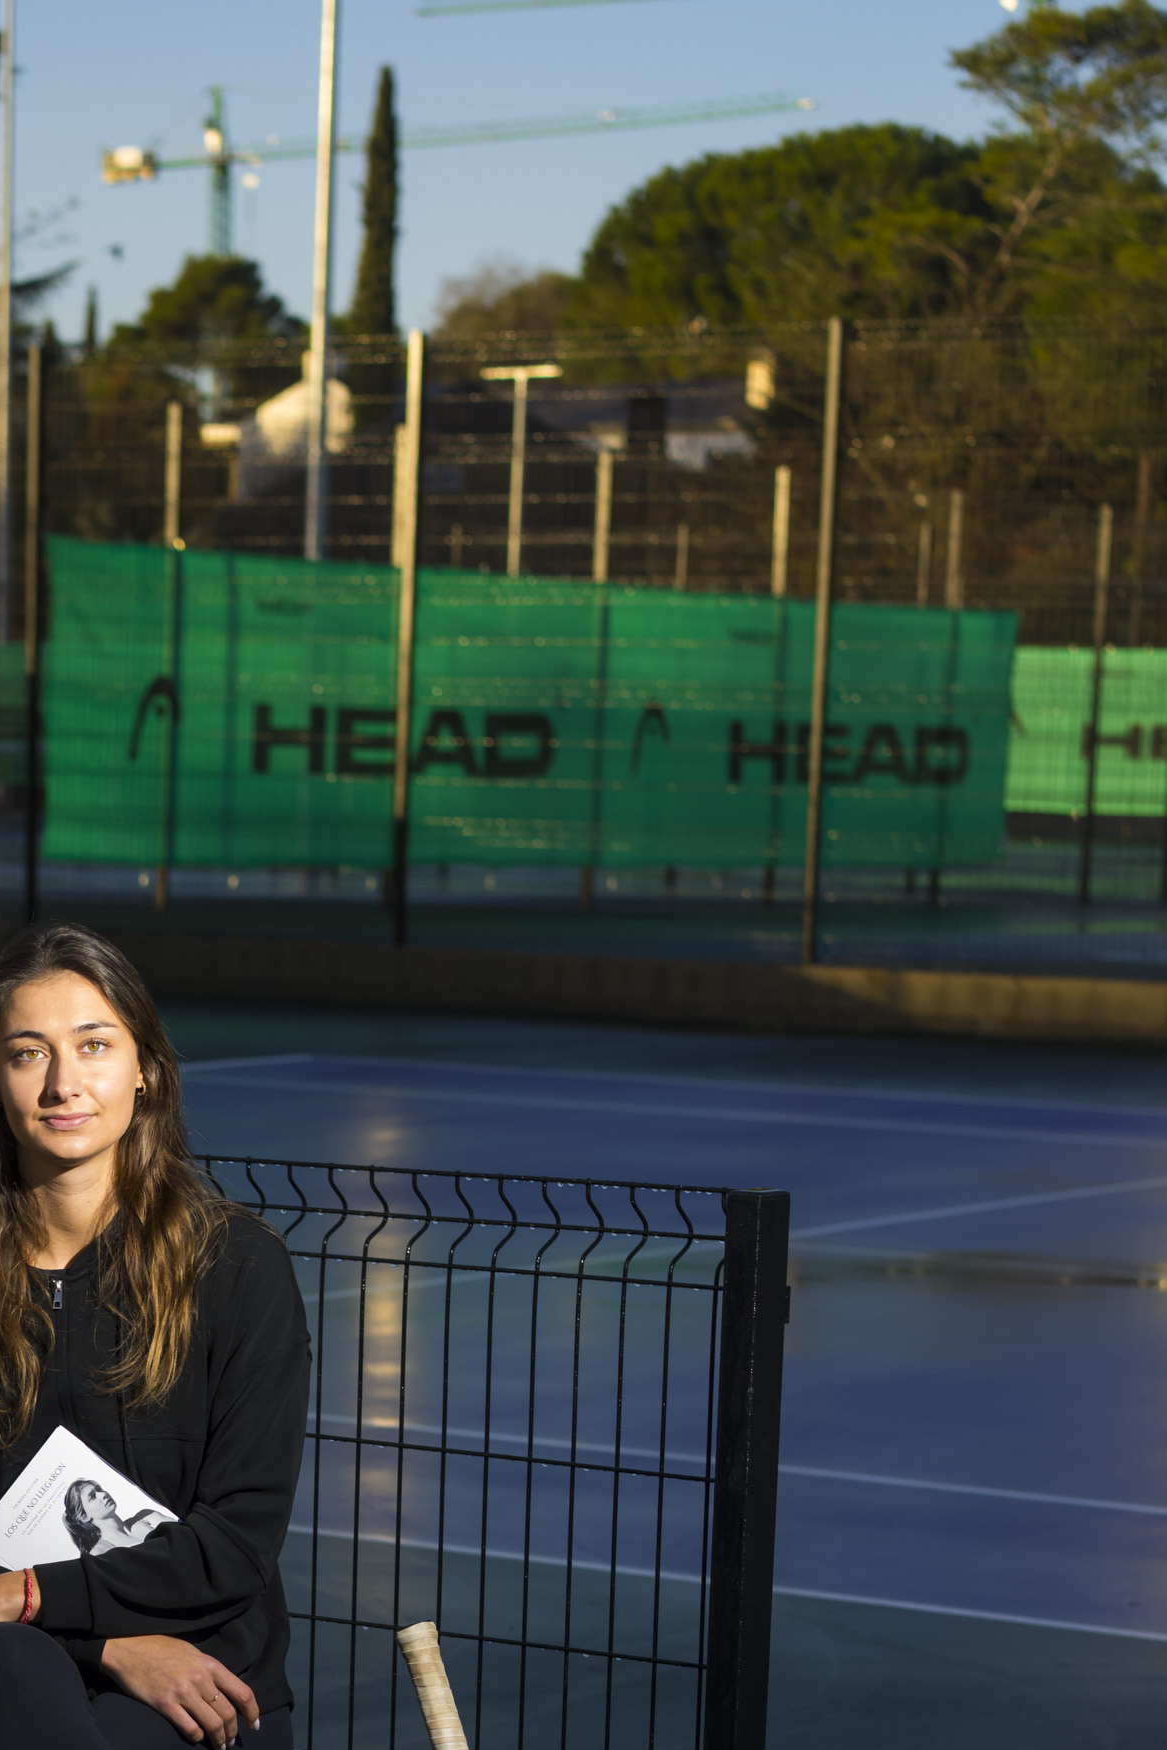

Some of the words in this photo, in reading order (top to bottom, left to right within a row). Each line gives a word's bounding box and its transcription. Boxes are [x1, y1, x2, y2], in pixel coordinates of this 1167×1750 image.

[253, 704, 556, 775] HEAD
[728, 720, 970, 785] HEAD
[3, 1522, 18, 1538] LOS
[15, 1508, 30, 1524] QUE
[26, 1497, 38, 1510] NO
[35, 1462, 66, 1499] LLEGARON
